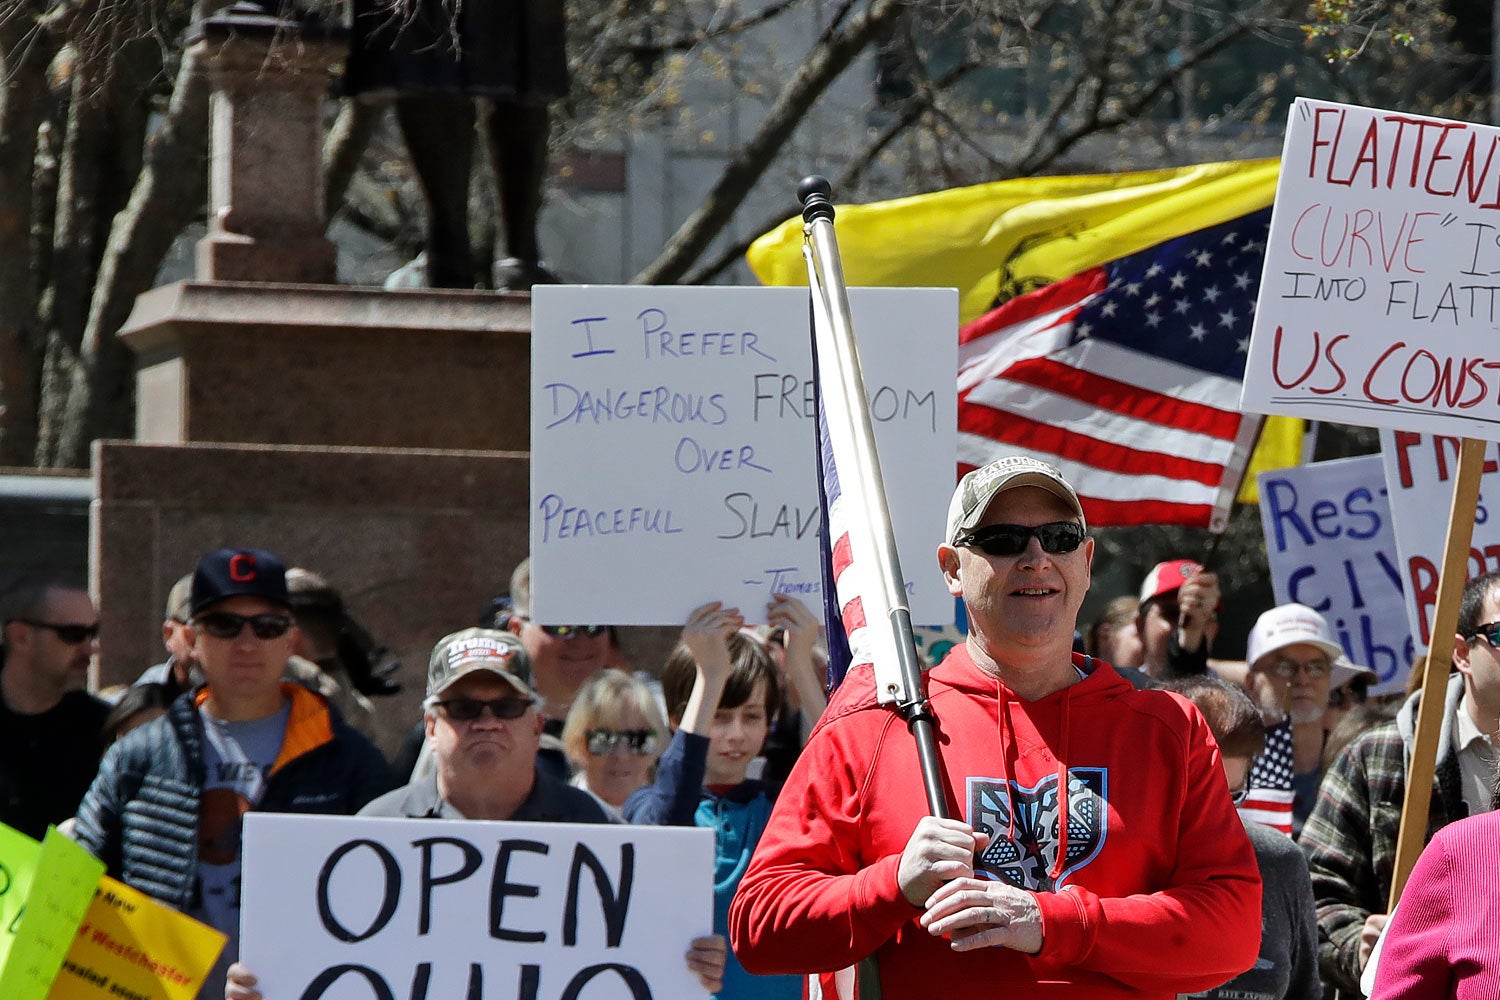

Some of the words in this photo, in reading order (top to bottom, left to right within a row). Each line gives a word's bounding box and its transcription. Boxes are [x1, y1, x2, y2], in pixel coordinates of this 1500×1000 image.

[1282, 272, 1366, 301] INTO
[571, 317, 615, 358] I
[544, 383, 728, 429] DANGEROUS
[753, 374, 936, 433] FREOM
[675, 437, 773, 473] OVER
[539, 494, 683, 543] PEACEFUL
[229, 554, 257, 582] C
[316, 837, 634, 948] OPEN
